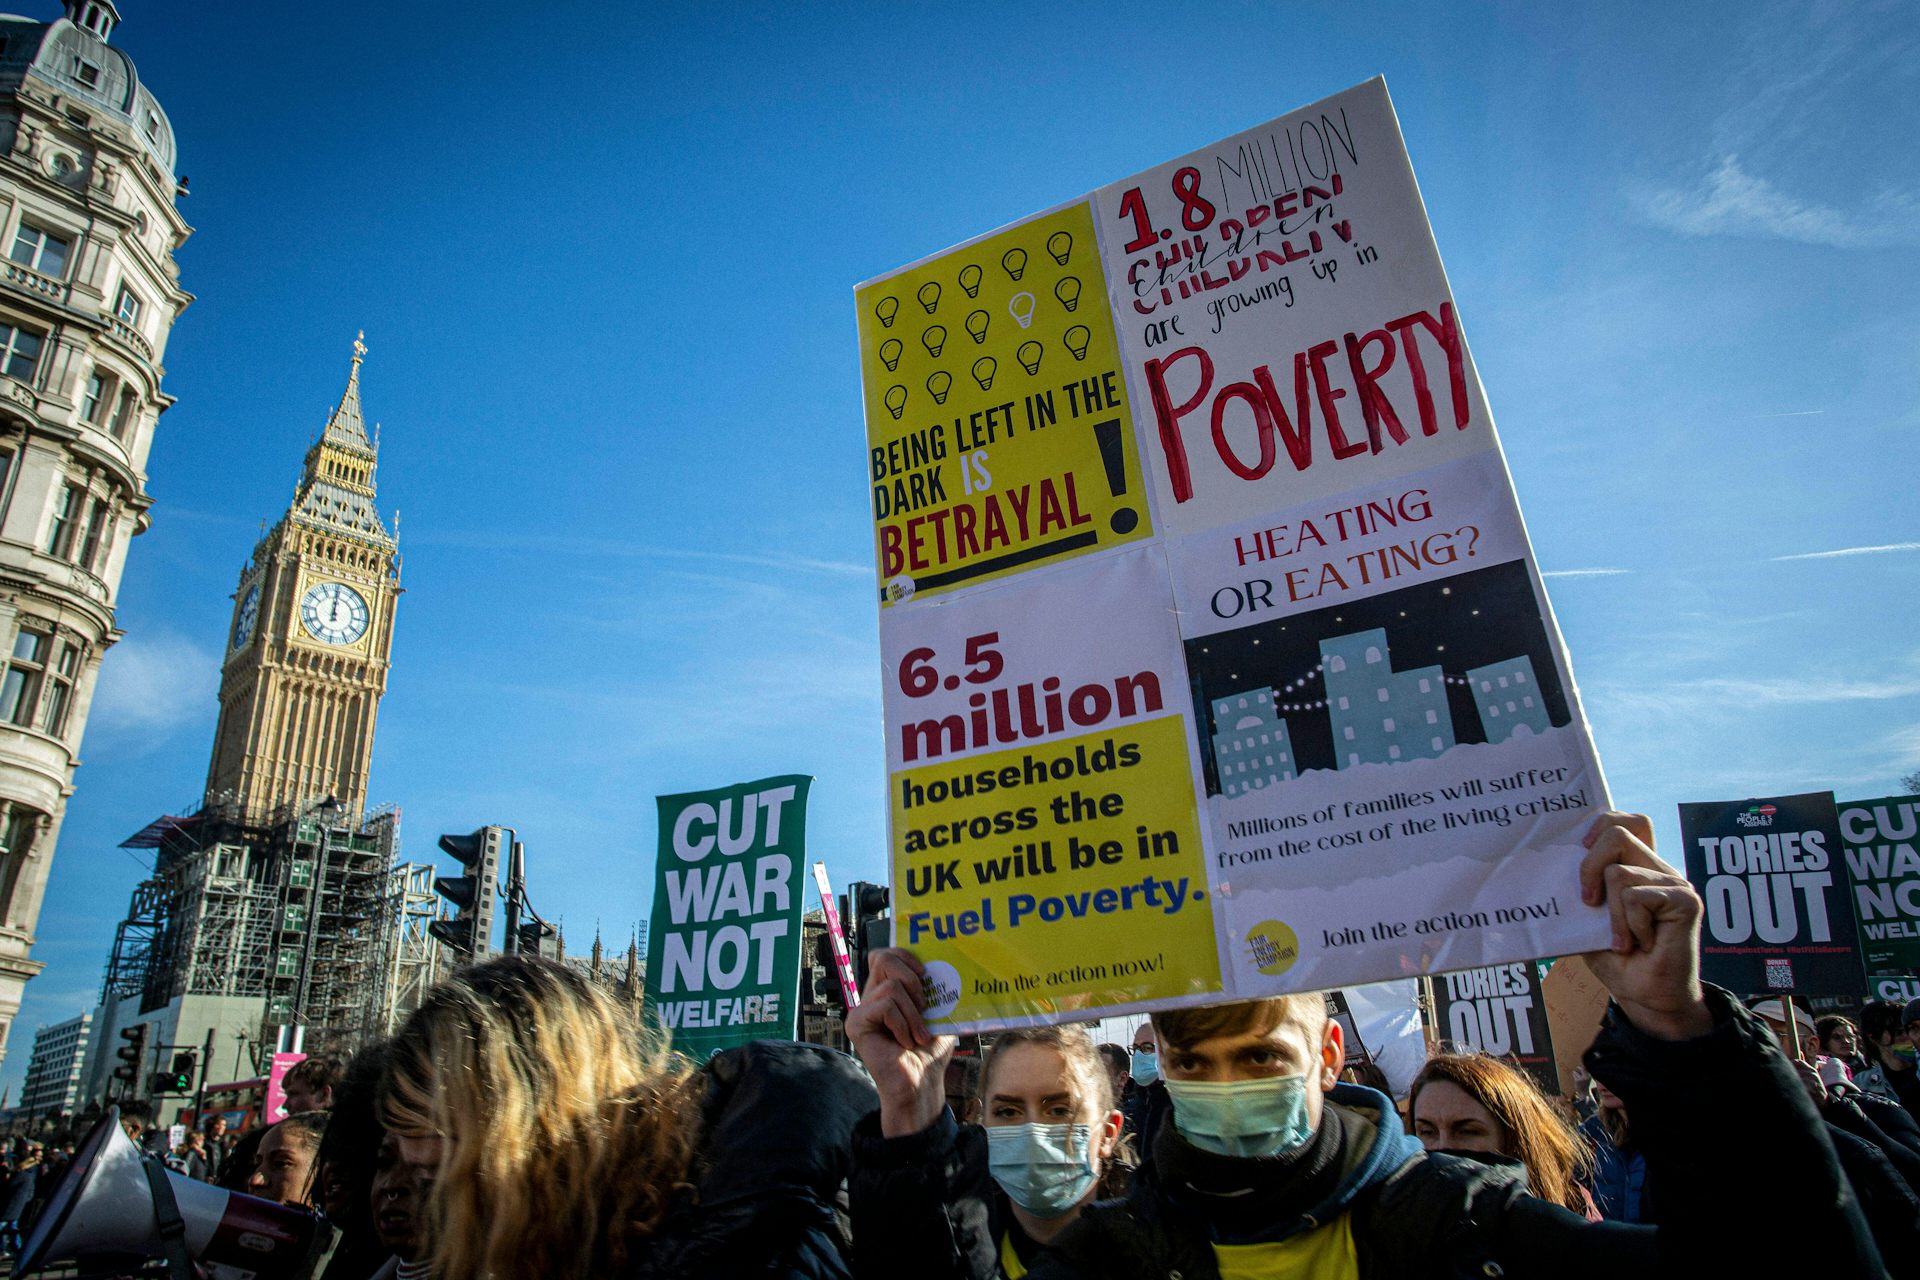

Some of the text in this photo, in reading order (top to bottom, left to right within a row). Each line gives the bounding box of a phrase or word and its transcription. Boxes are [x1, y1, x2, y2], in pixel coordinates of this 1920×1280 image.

[1118, 107, 1358, 255] 1.8 MILLION
[1144, 242, 1379, 347] are growing up in
[871, 371, 1122, 482] BEING LEFT IN THE
[1144, 301, 1470, 504] POVERTY
[874, 450, 993, 521] DARK IS
[1233, 488, 1434, 566] HEATING
[1210, 525, 1480, 619] OR EATING?
[898, 631, 1004, 698] 6.5
[901, 670, 1164, 763] million
[902, 739, 1142, 810] households
[1227, 766, 1569, 841] Millions of families will suffer
[672, 785, 796, 862] CUT
[904, 791, 1124, 854] across the
[1217, 789, 1589, 869] from the cost of the living crisis!
[1697, 830, 1830, 876] TORIES
[1839, 803, 1920, 844] CU
[664, 853, 793, 925] WAR
[906, 825, 1180, 898] UK will be in
[908, 875, 1206, 945] Fuel Poverty.
[1320, 896, 1562, 949] Join the action now!
[1704, 870, 1833, 944] OUT
[1862, 920, 1920, 941] WEL
[659, 918, 789, 994] NOT
[971, 953, 1165, 996] Join the action now!
[1442, 962, 1531, 1001] TORIES
[656, 993, 781, 1029] WELFARE
[1448, 994, 1535, 1058] OUT
